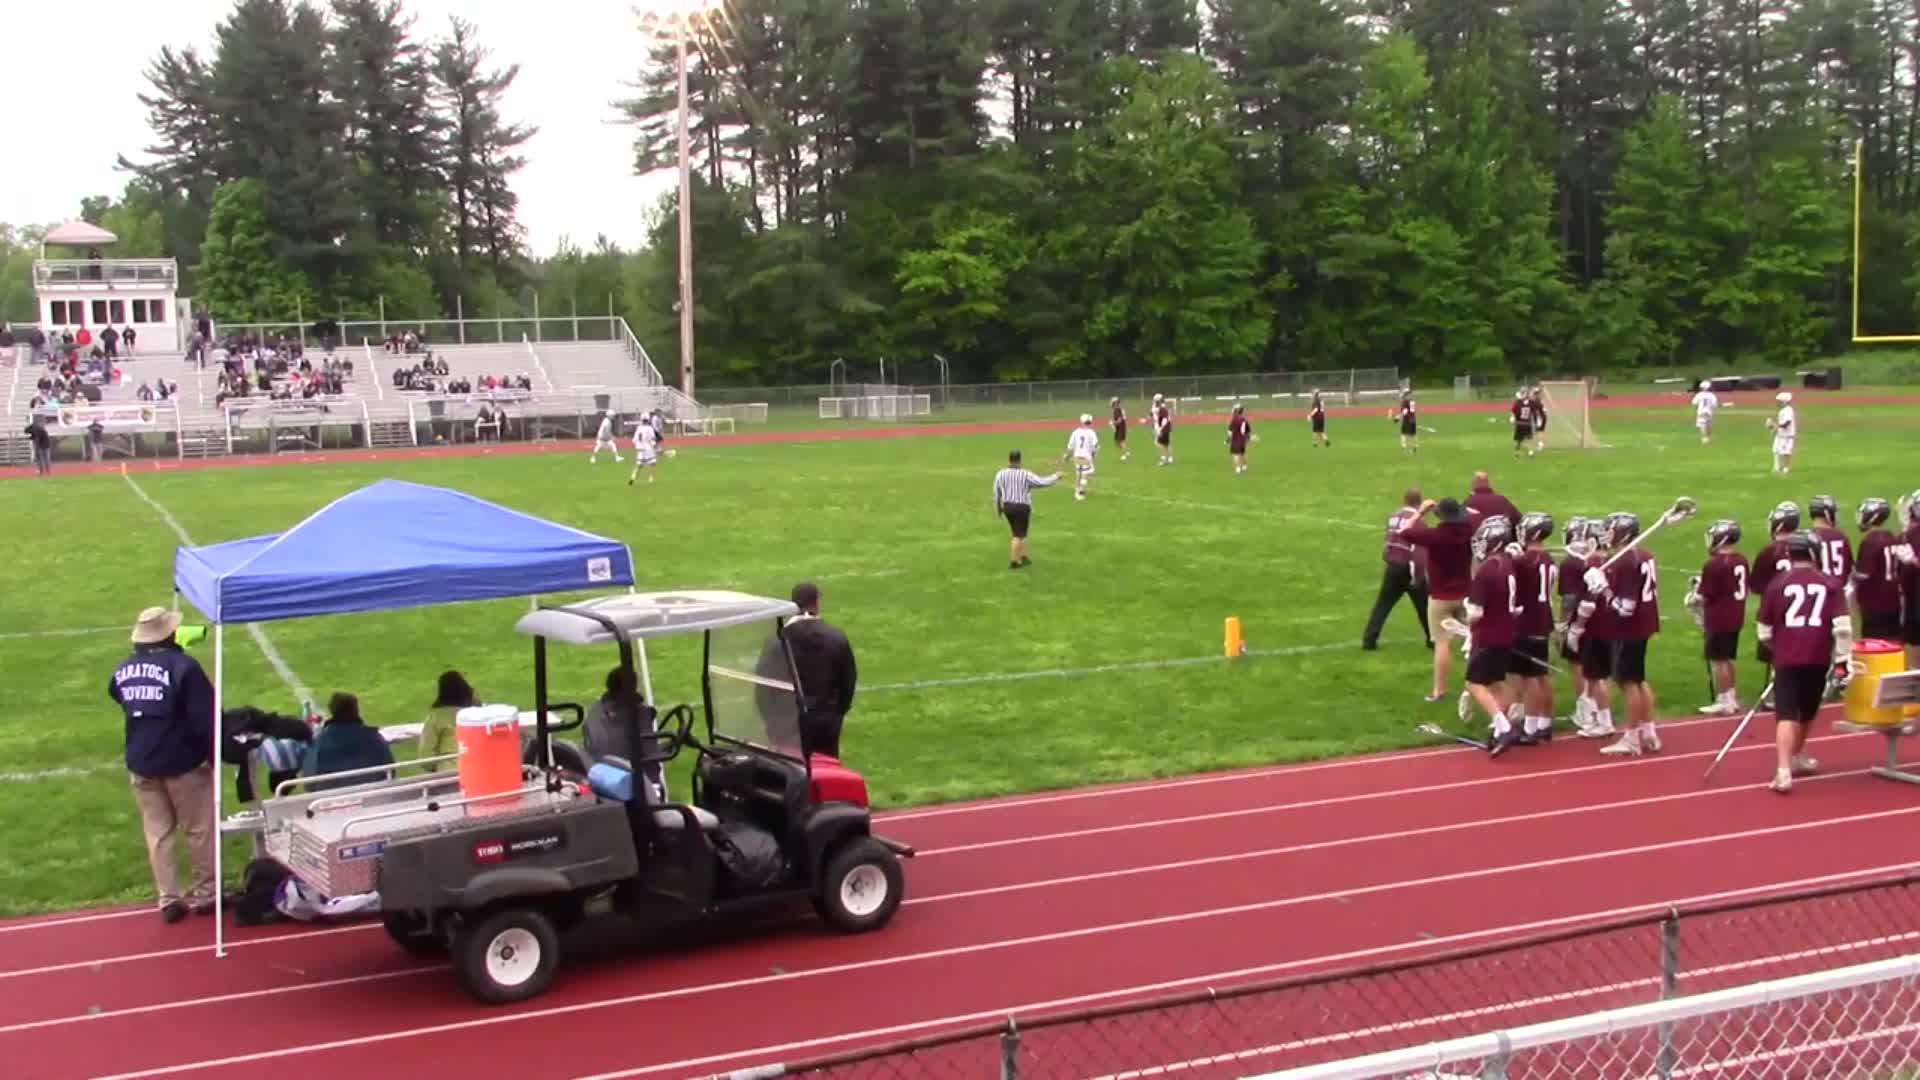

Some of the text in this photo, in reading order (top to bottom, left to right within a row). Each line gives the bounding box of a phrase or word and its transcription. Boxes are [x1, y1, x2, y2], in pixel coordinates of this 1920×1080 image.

[1821, 540, 1844, 576] 15
[1733, 565, 1747, 600] 3
[1783, 583, 1827, 627] 27
[115, 663, 170, 686] SARATOGA
